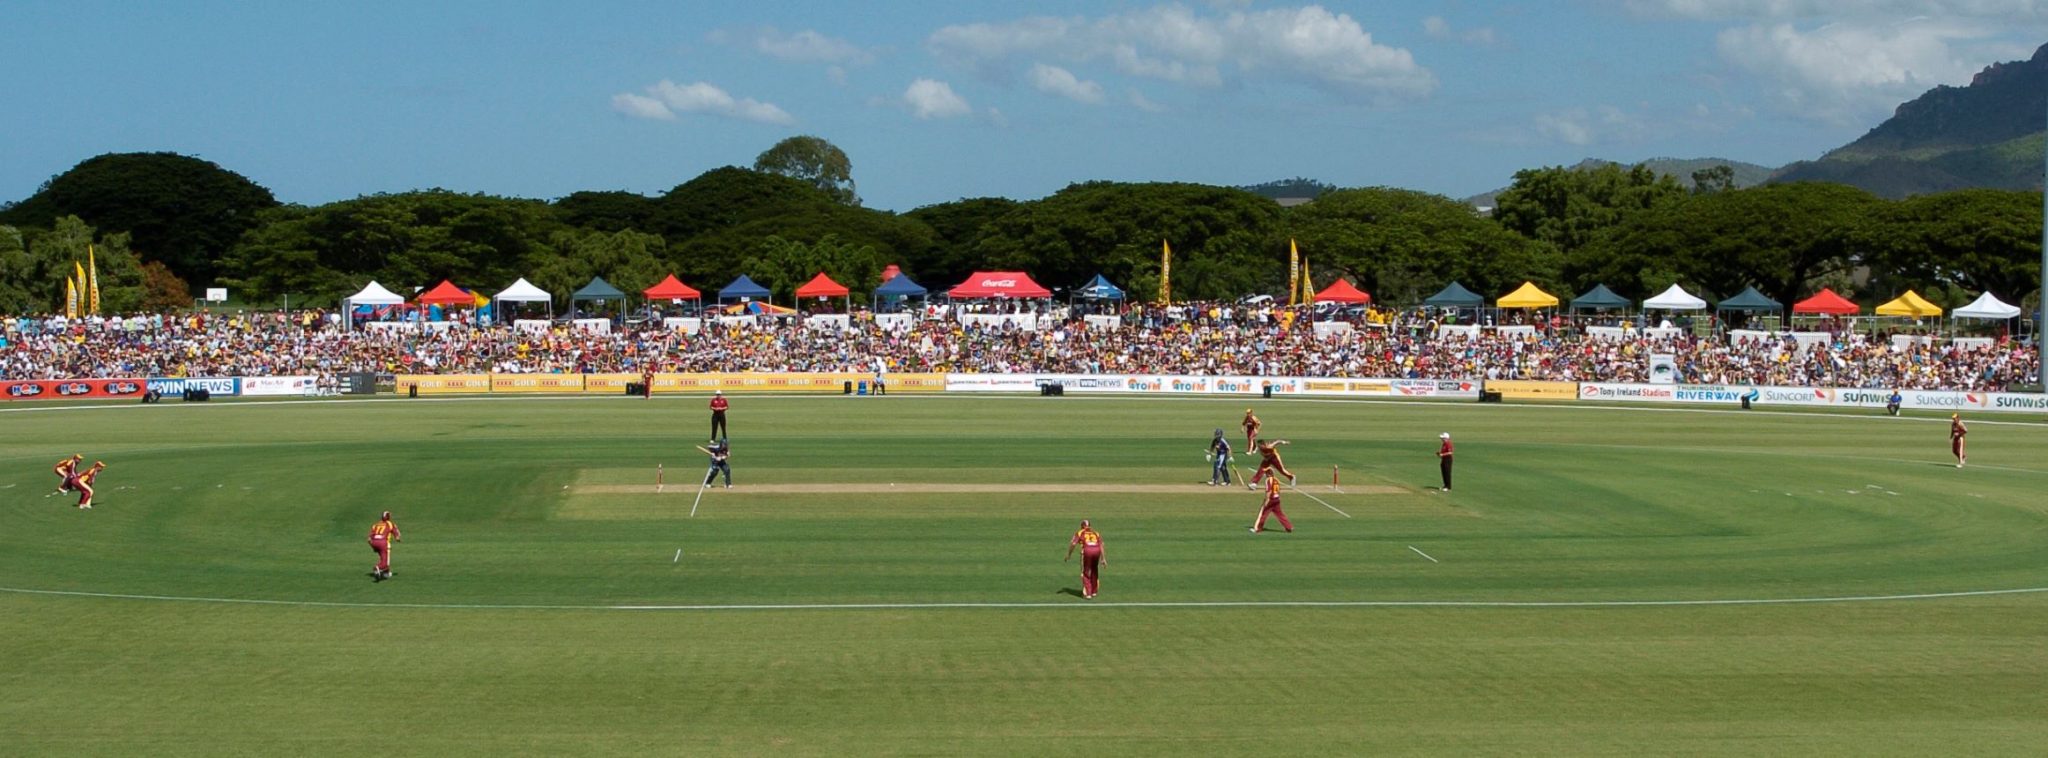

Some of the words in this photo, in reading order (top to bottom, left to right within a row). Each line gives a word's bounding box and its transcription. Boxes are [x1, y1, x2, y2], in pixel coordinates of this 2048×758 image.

[159, 381, 184, 394] WIN
[187, 380, 232, 393] NEWS
[1600, 387, 1615, 397] Tony
[1617, 388, 1641, 396] Ireland
[1642, 388, 1670, 397] Stadium
[1676, 391, 1740, 400] RIVERWAY
[1766, 390, 1815, 401] SUNCORP
[1916, 394, 1966, 406] SUNCORP
